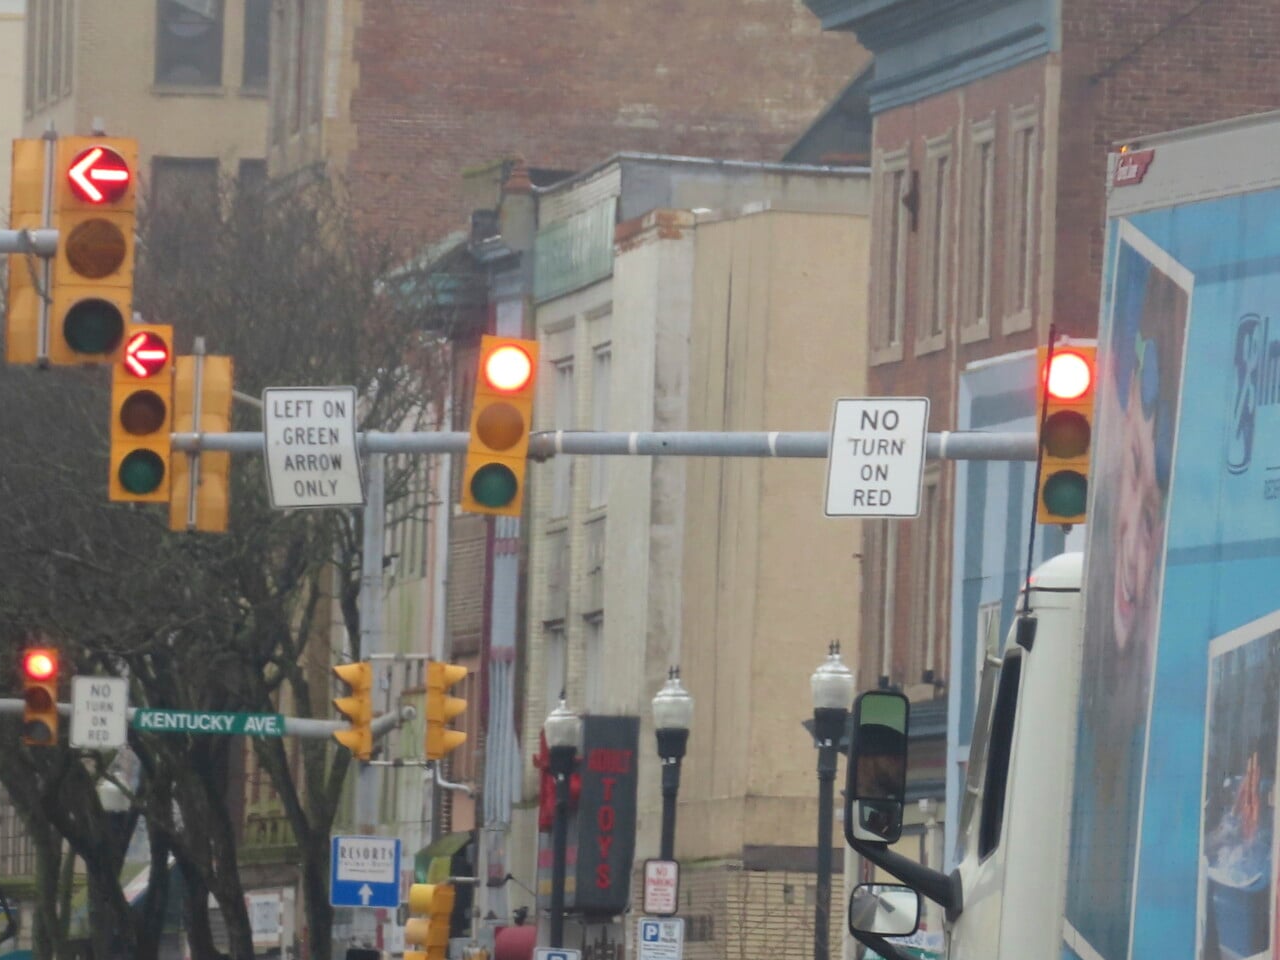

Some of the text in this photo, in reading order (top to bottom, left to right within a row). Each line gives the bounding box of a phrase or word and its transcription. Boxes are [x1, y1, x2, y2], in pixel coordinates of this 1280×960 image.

[274, 400, 346, 418] LEFT ON
[860, 409, 900, 431] NO
[283, 427, 339, 446] GREEN
[848, 438, 905, 457] TURN
[284, 454, 342, 472] ARROW
[860, 464, 888, 481] ON
[294, 479, 338, 498] ONLY
[853, 489, 892, 507] RED
[91, 683, 111, 698] NO
[86, 700, 114, 713] TURN
[91, 715, 107, 727] ON
[140, 711, 235, 731] KENTUCKY
[88, 729, 110, 742] RED
[595, 778, 617, 889] TOYS
[340, 845, 394, 860] RESORTS
